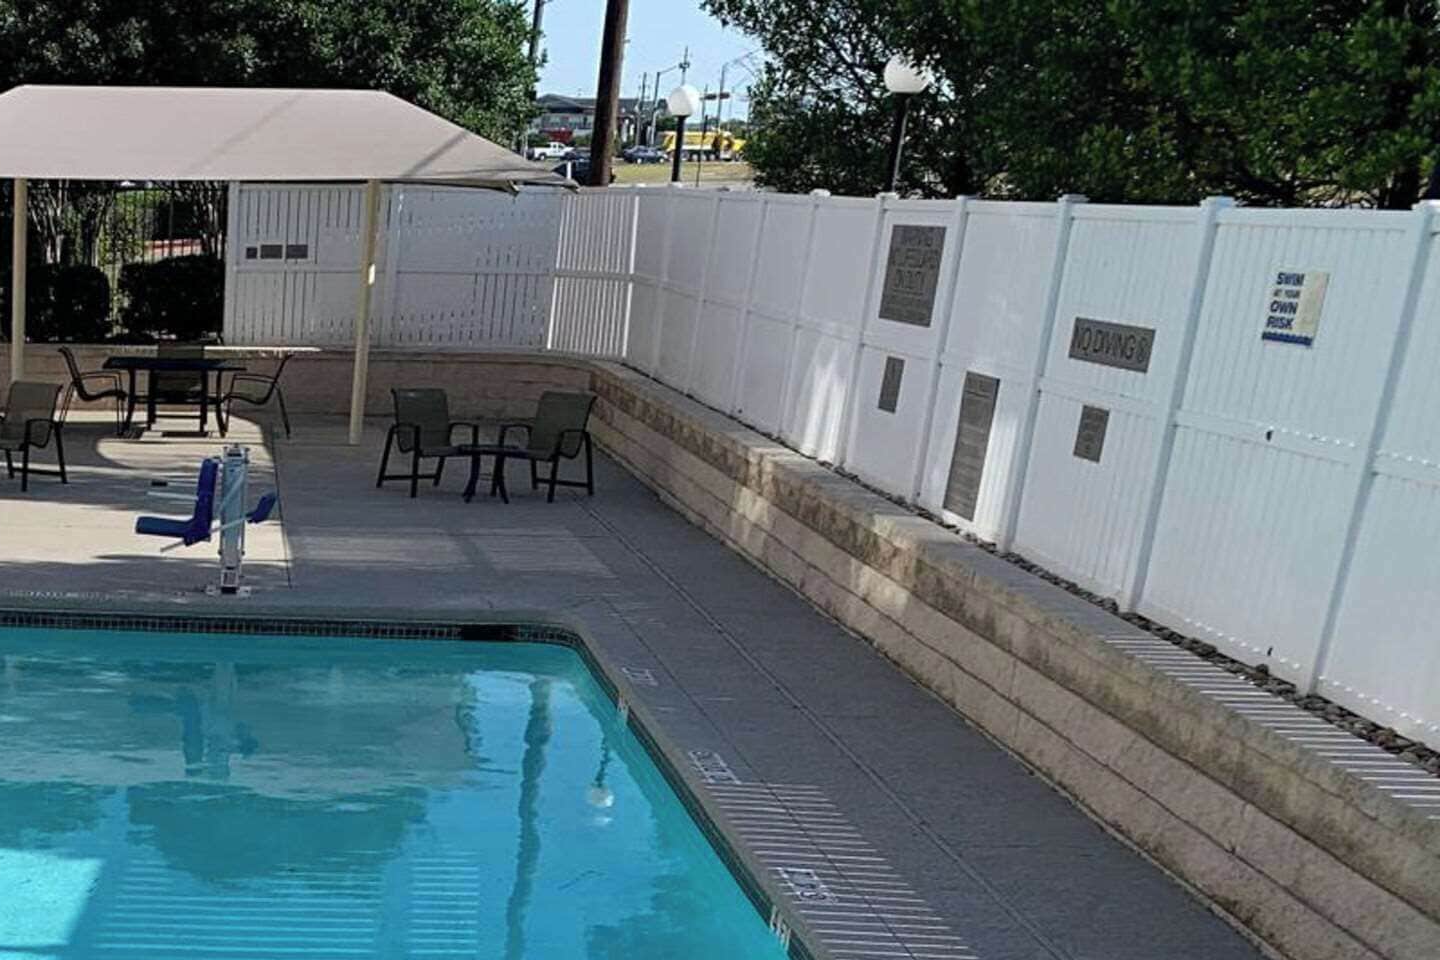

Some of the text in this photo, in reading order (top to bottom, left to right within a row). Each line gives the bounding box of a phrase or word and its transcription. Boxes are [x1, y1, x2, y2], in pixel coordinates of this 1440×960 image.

[1276, 271, 1305, 286] SWIM
[1269, 300, 1299, 315] OWN
[1265, 315, 1295, 331] RISK
